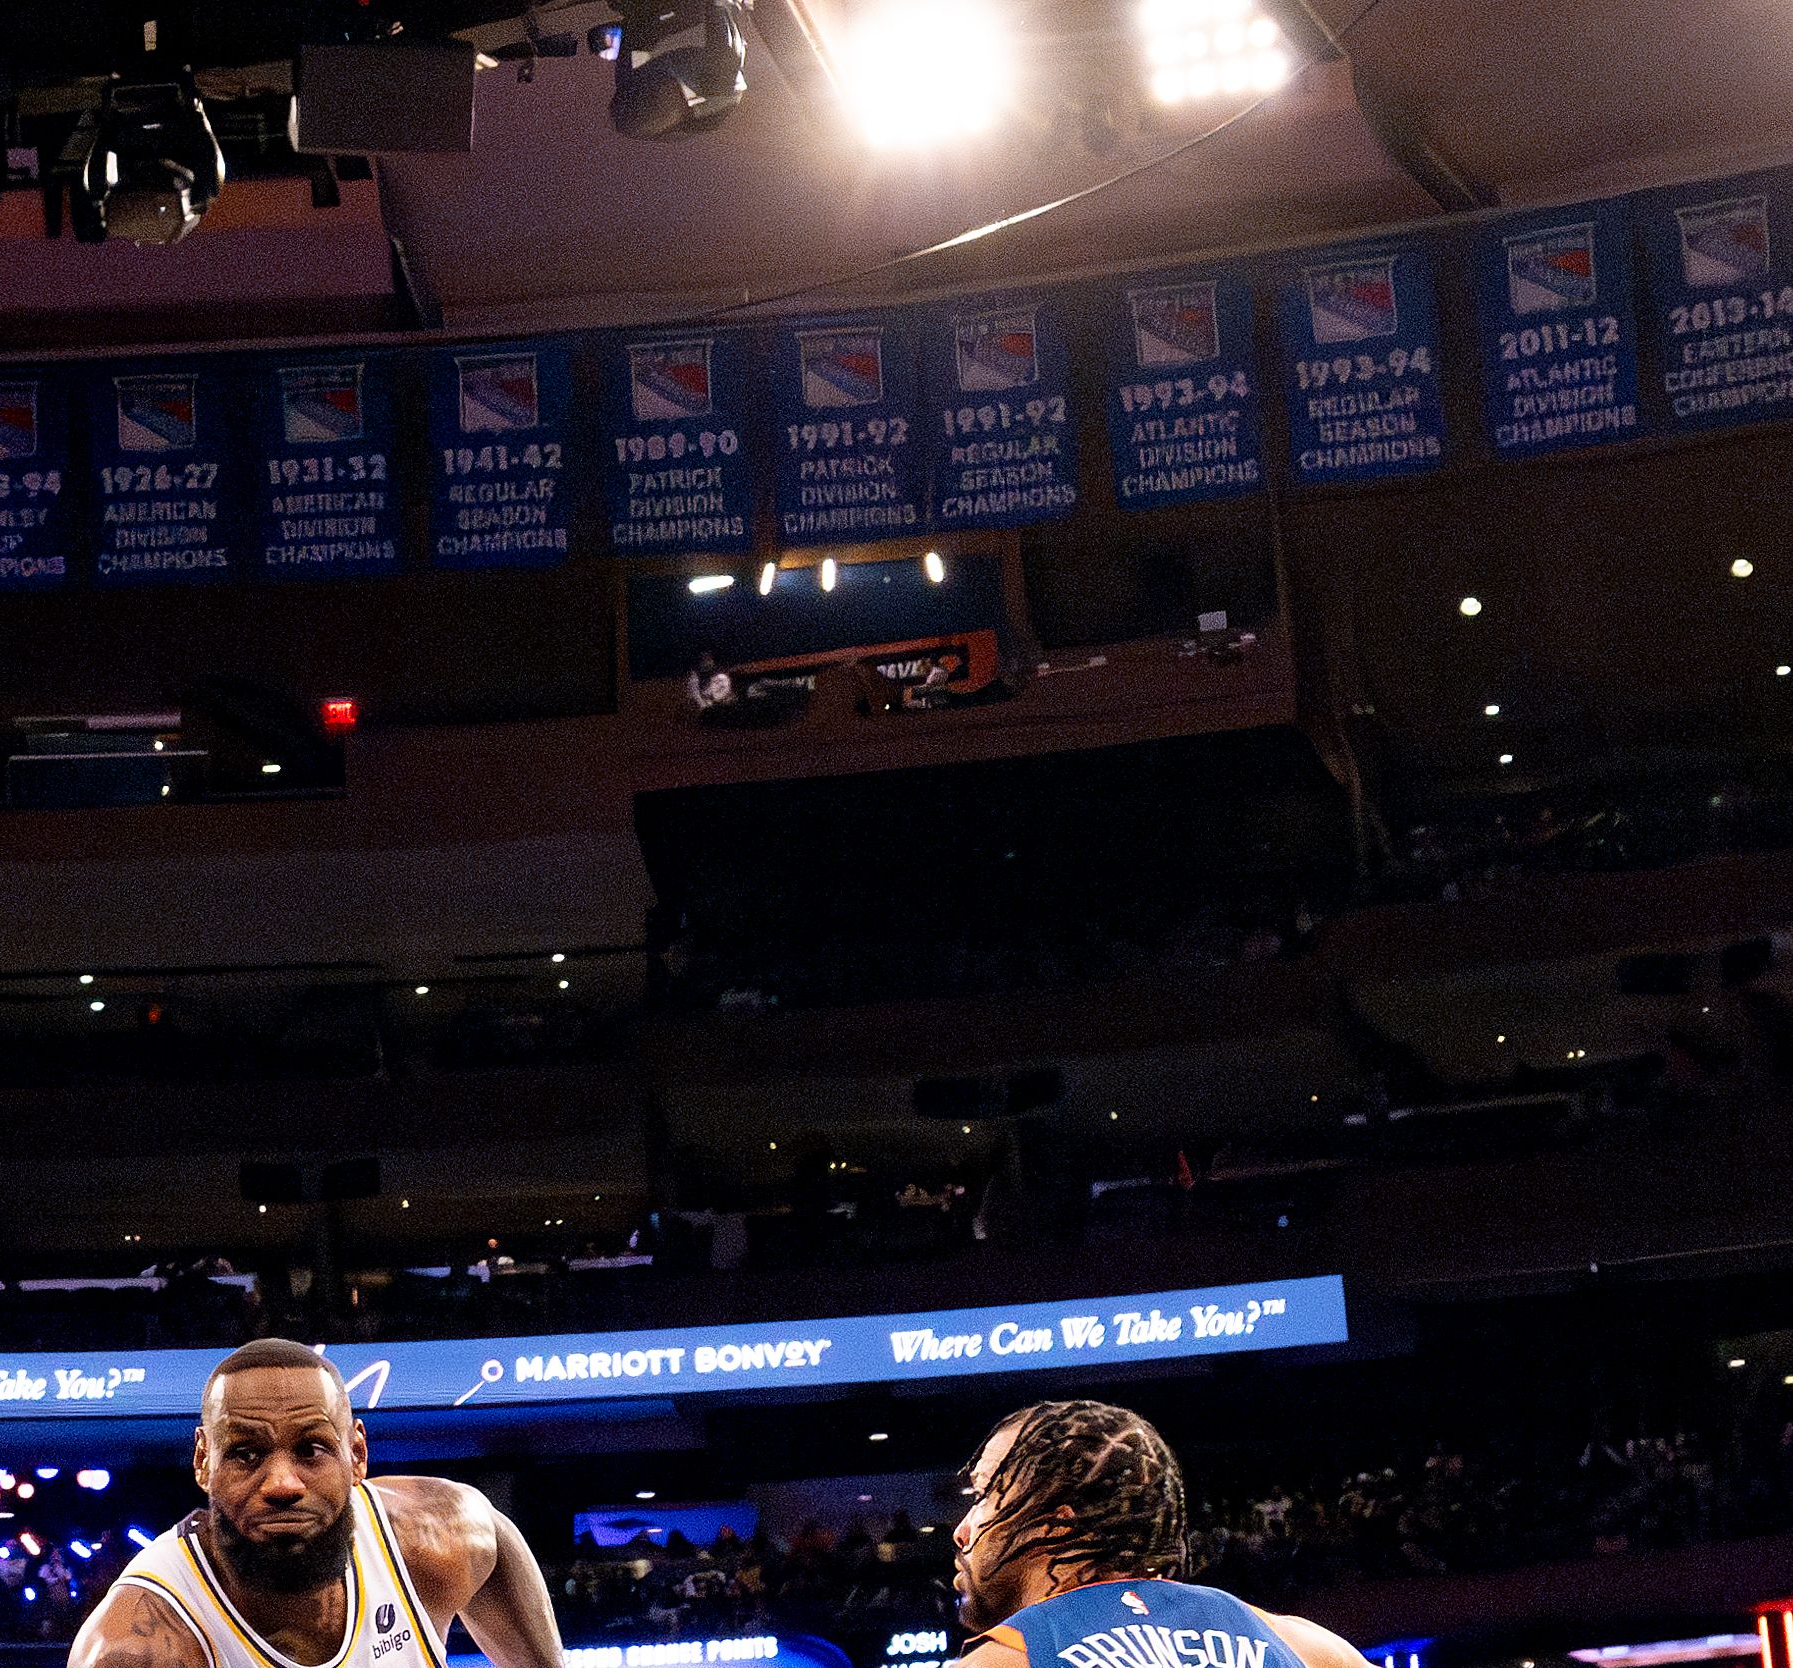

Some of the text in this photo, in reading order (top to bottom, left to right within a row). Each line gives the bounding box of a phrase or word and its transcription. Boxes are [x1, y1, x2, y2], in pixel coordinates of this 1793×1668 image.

[1498, 315, 1620, 361] 2011-12
[1295, 346, 1431, 390] 1993-94
[1507, 354, 1618, 392] ATLANTIC
[1307, 386, 1421, 419] REGULAR
[1513, 383, 1615, 418] DIVISION
[787, 417, 909, 451] 1991-92
[1130, 410, 1240, 443] ATLANTIC
[1318, 416, 1417, 445] SEASON
[1495, 404, 1637, 448] CHAMPIONS
[442, 442, 563, 476] 1941-42
[950, 435, 1060, 465] REGULAR
[1138, 437, 1237, 470] DIVISION
[1299, 437, 1441, 473] CHAMPIONS
[100, 462, 220, 494] 1926-27
[267, 454, 388, 486] 1931-32
[629, 466, 722, 493] PATRICK
[800, 454, 894, 481] PATRICK
[960, 462, 1054, 492] SEASON
[1121, 460, 1259, 498] CHAMPIONS
[448, 478, 556, 504] REGULAR
[629, 492, 725, 518] DIVISION
[800, 481, 897, 507] DIVISION
[941, 485, 1077, 519] CHAMPIONS
[103, 499, 218, 524] AMERICAN
[456, 504, 547, 531] SEASON
[783, 504, 916, 535] CHAMPIONS
[436, 528, 567, 556] CHAMPIONS
[613, 516, 744, 545] CHAMPIONS
[97, 547, 229, 574] CHAMPIONS
[265, 540, 396, 566] CHAMPIONS
[890, 1326, 984, 1365] Where
[989, 1321, 1055, 1357] Can
[1060, 1314, 1106, 1351] We
[1113, 1308, 1183, 1347] Take
[515, 1338, 833, 1384] MARRIOTT BONVOY
[371, 1629, 412, 1660] bibigo
[707, 1636, 779, 1663] POINTS
[886, 1631, 948, 1656] JOSH
